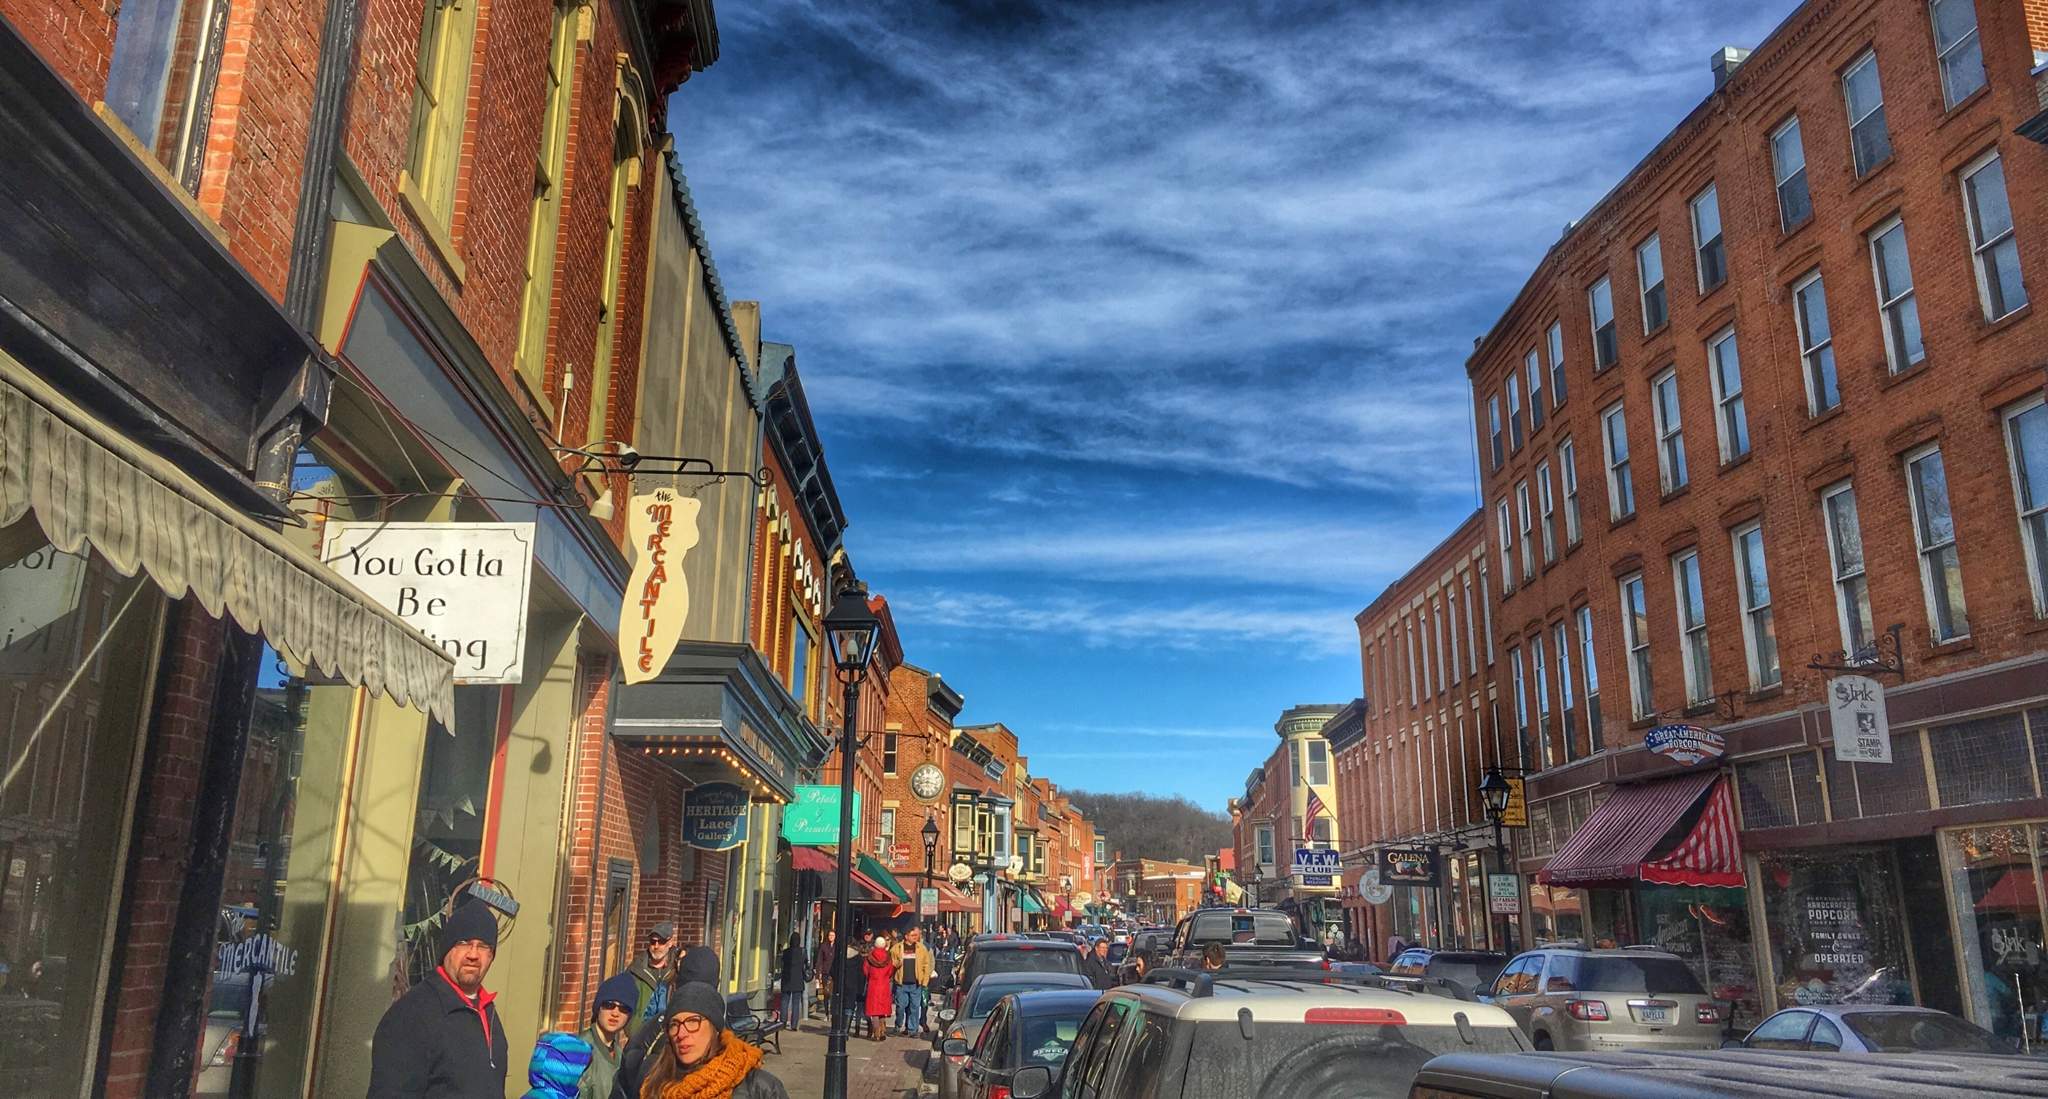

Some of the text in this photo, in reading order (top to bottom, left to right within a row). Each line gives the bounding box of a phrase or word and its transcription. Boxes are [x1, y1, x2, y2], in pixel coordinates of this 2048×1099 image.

[655, 490, 674, 502] the
[350, 546, 503, 577] You Gotta
[637, 504, 673, 673] MERCANTILE
[397, 587, 447, 617] Be
[1654, 728, 1716, 743] GREAT AMERICAN
[1668, 738, 1703, 749] POPCORN
[1857, 738, 1881, 749] STAMP
[686, 804, 747, 817] HERITAGE
[699, 818, 732, 830] Lace
[696, 831, 733, 842] Gallery
[1387, 852, 1430, 864] GALENA
[1304, 866, 1332, 874] CLUB
[1808, 909, 1857, 920] POPCORN
[1811, 932, 1835, 940] FAMILY
[218, 933, 299, 981] MERCANTILE
[1814, 953, 1864, 964] OPERATED
